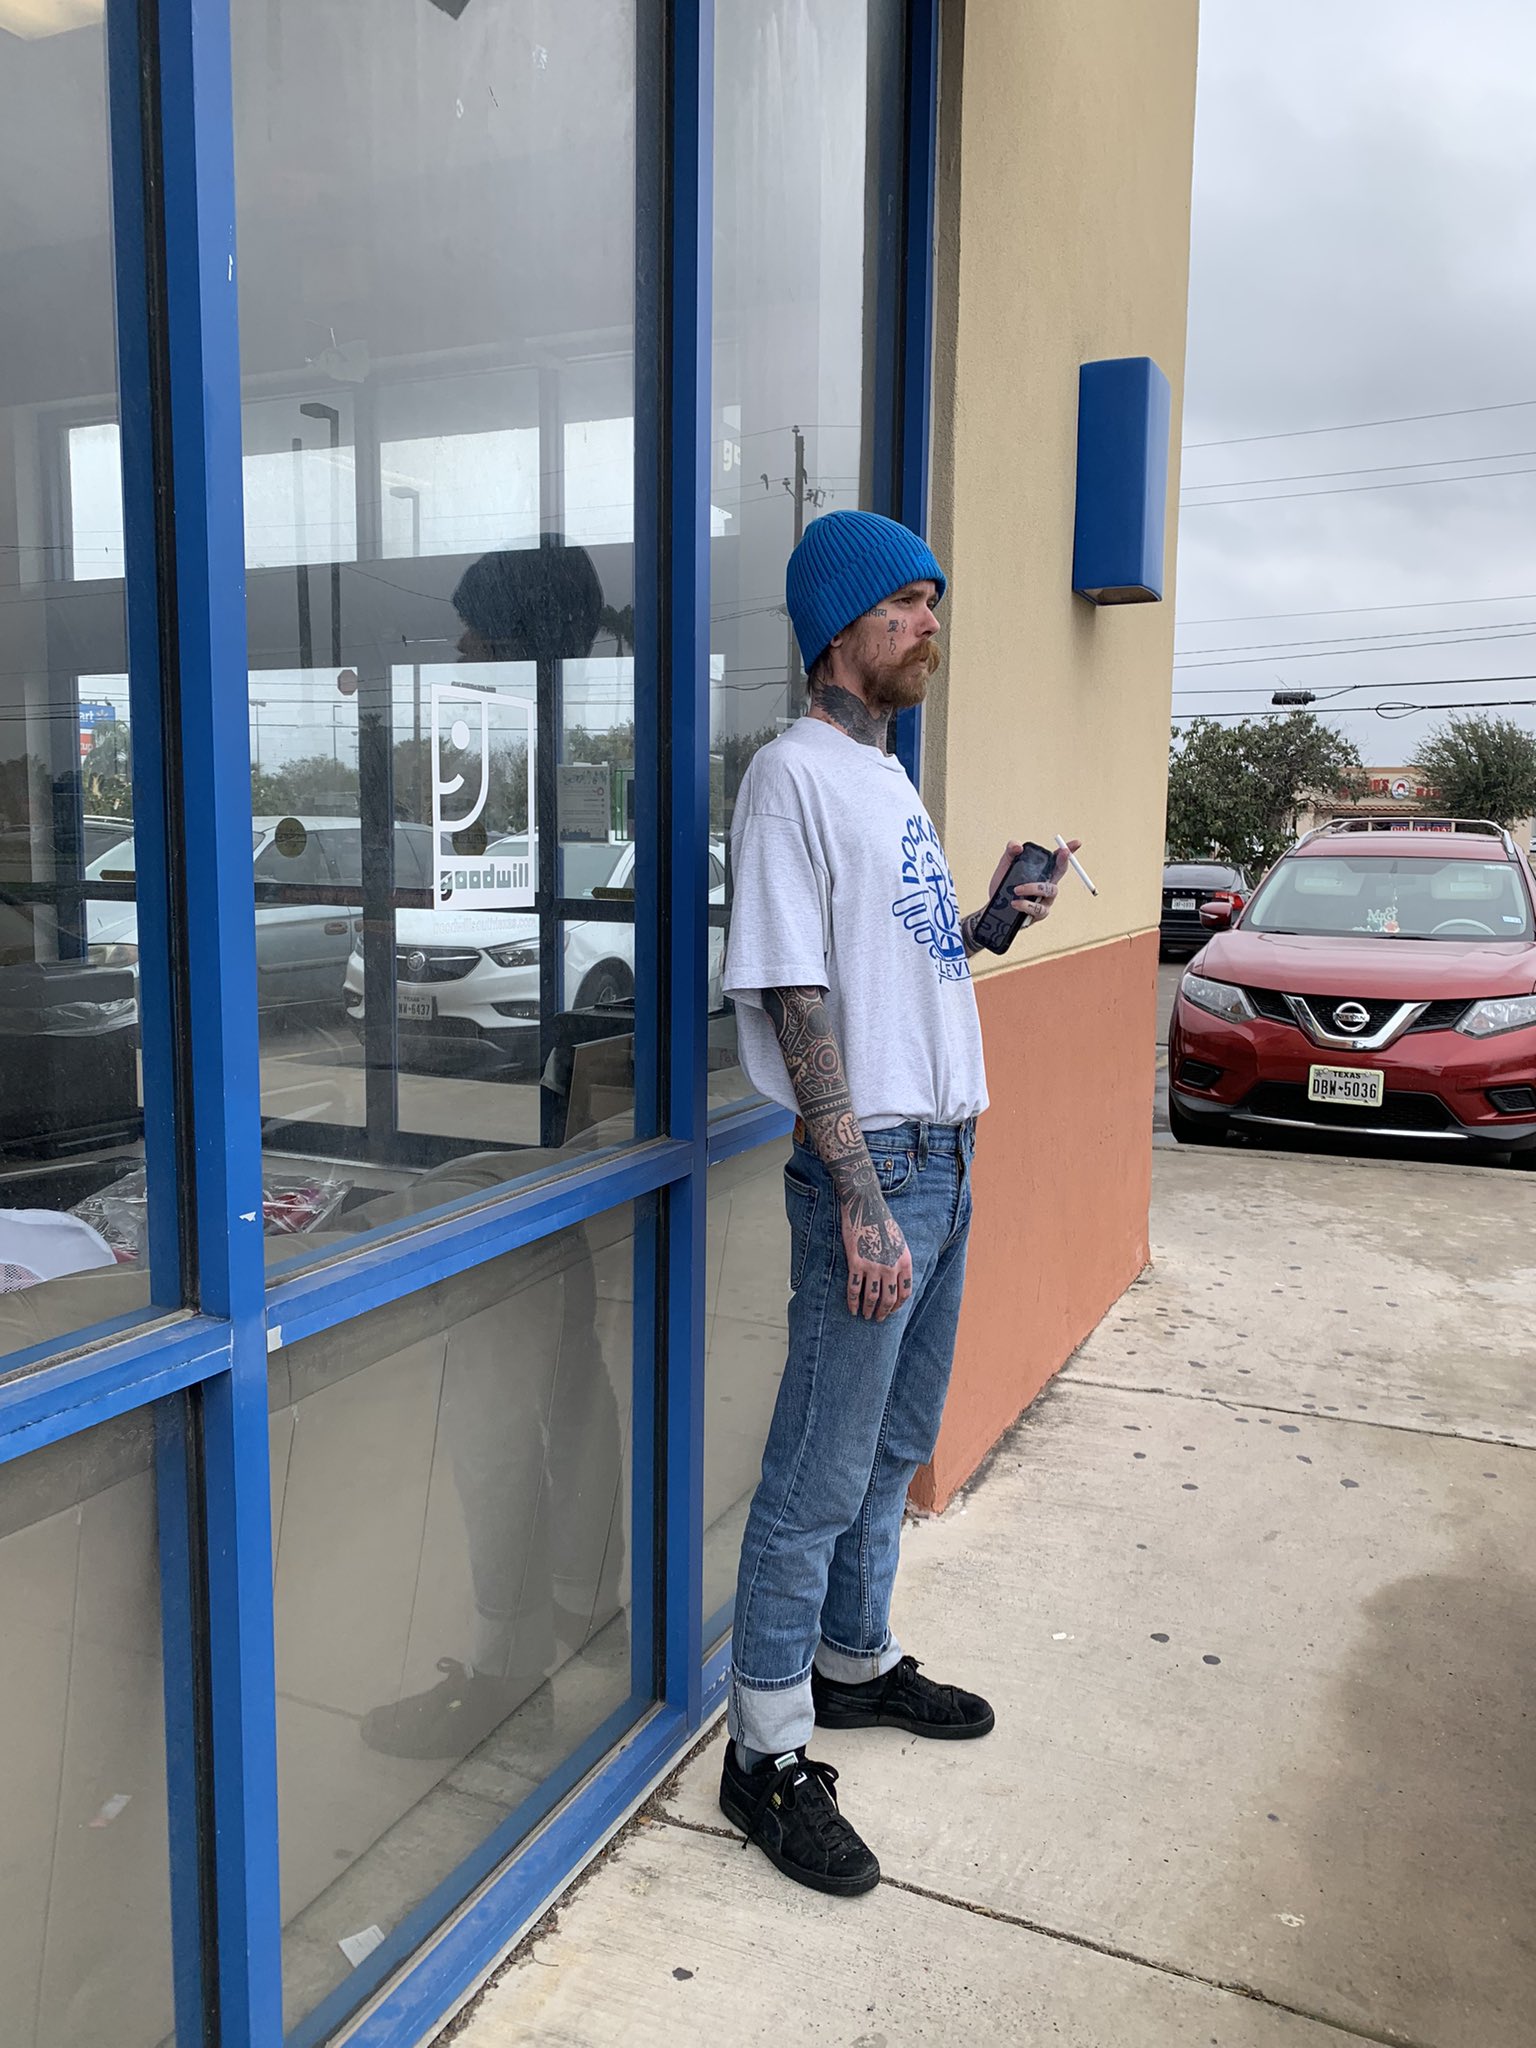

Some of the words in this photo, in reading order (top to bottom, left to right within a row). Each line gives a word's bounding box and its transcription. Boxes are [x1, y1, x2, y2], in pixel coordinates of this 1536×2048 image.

[902, 815, 953, 888] DOCKE
[440, 863, 529, 902] goodwill
[1333, 1070, 1361, 1080] TEXAS
